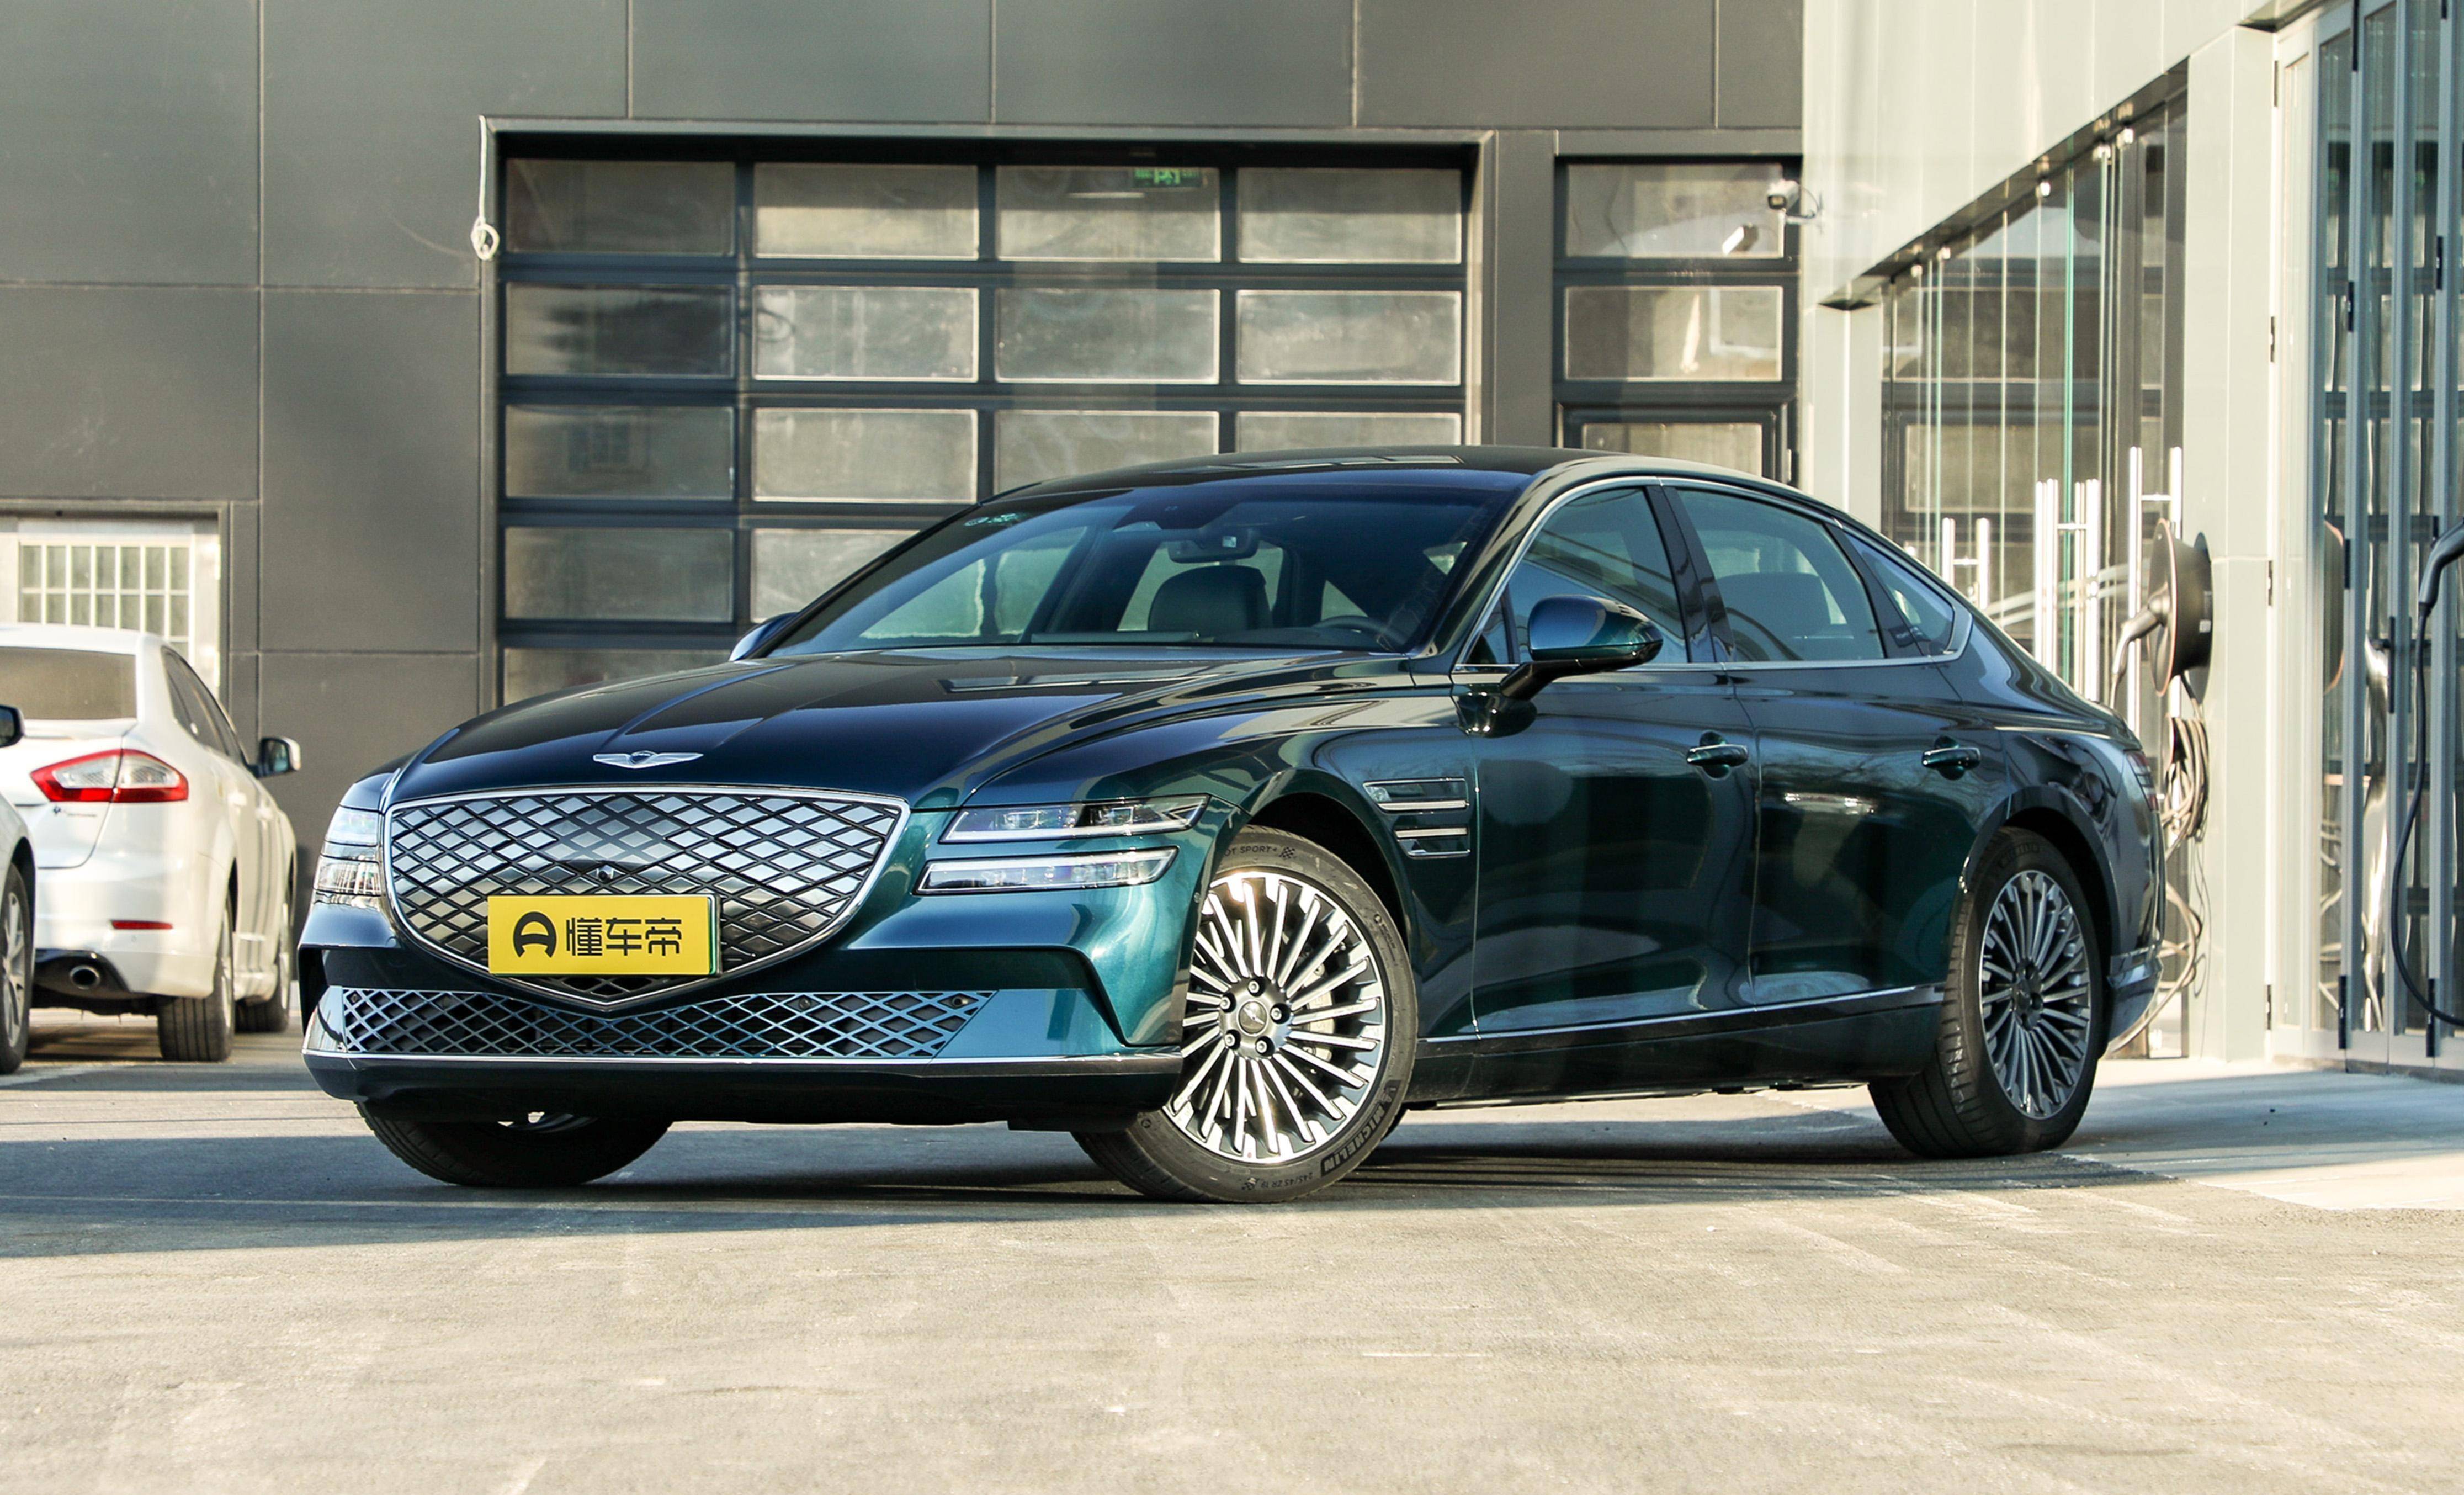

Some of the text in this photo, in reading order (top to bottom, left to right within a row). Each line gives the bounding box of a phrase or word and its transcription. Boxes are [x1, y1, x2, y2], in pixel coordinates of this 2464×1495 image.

[565, 917, 682, 956] 懂车帝
[1323, 1105, 1385, 1173] MICHELIN
[1283, 1171, 1313, 1186] 245/45
